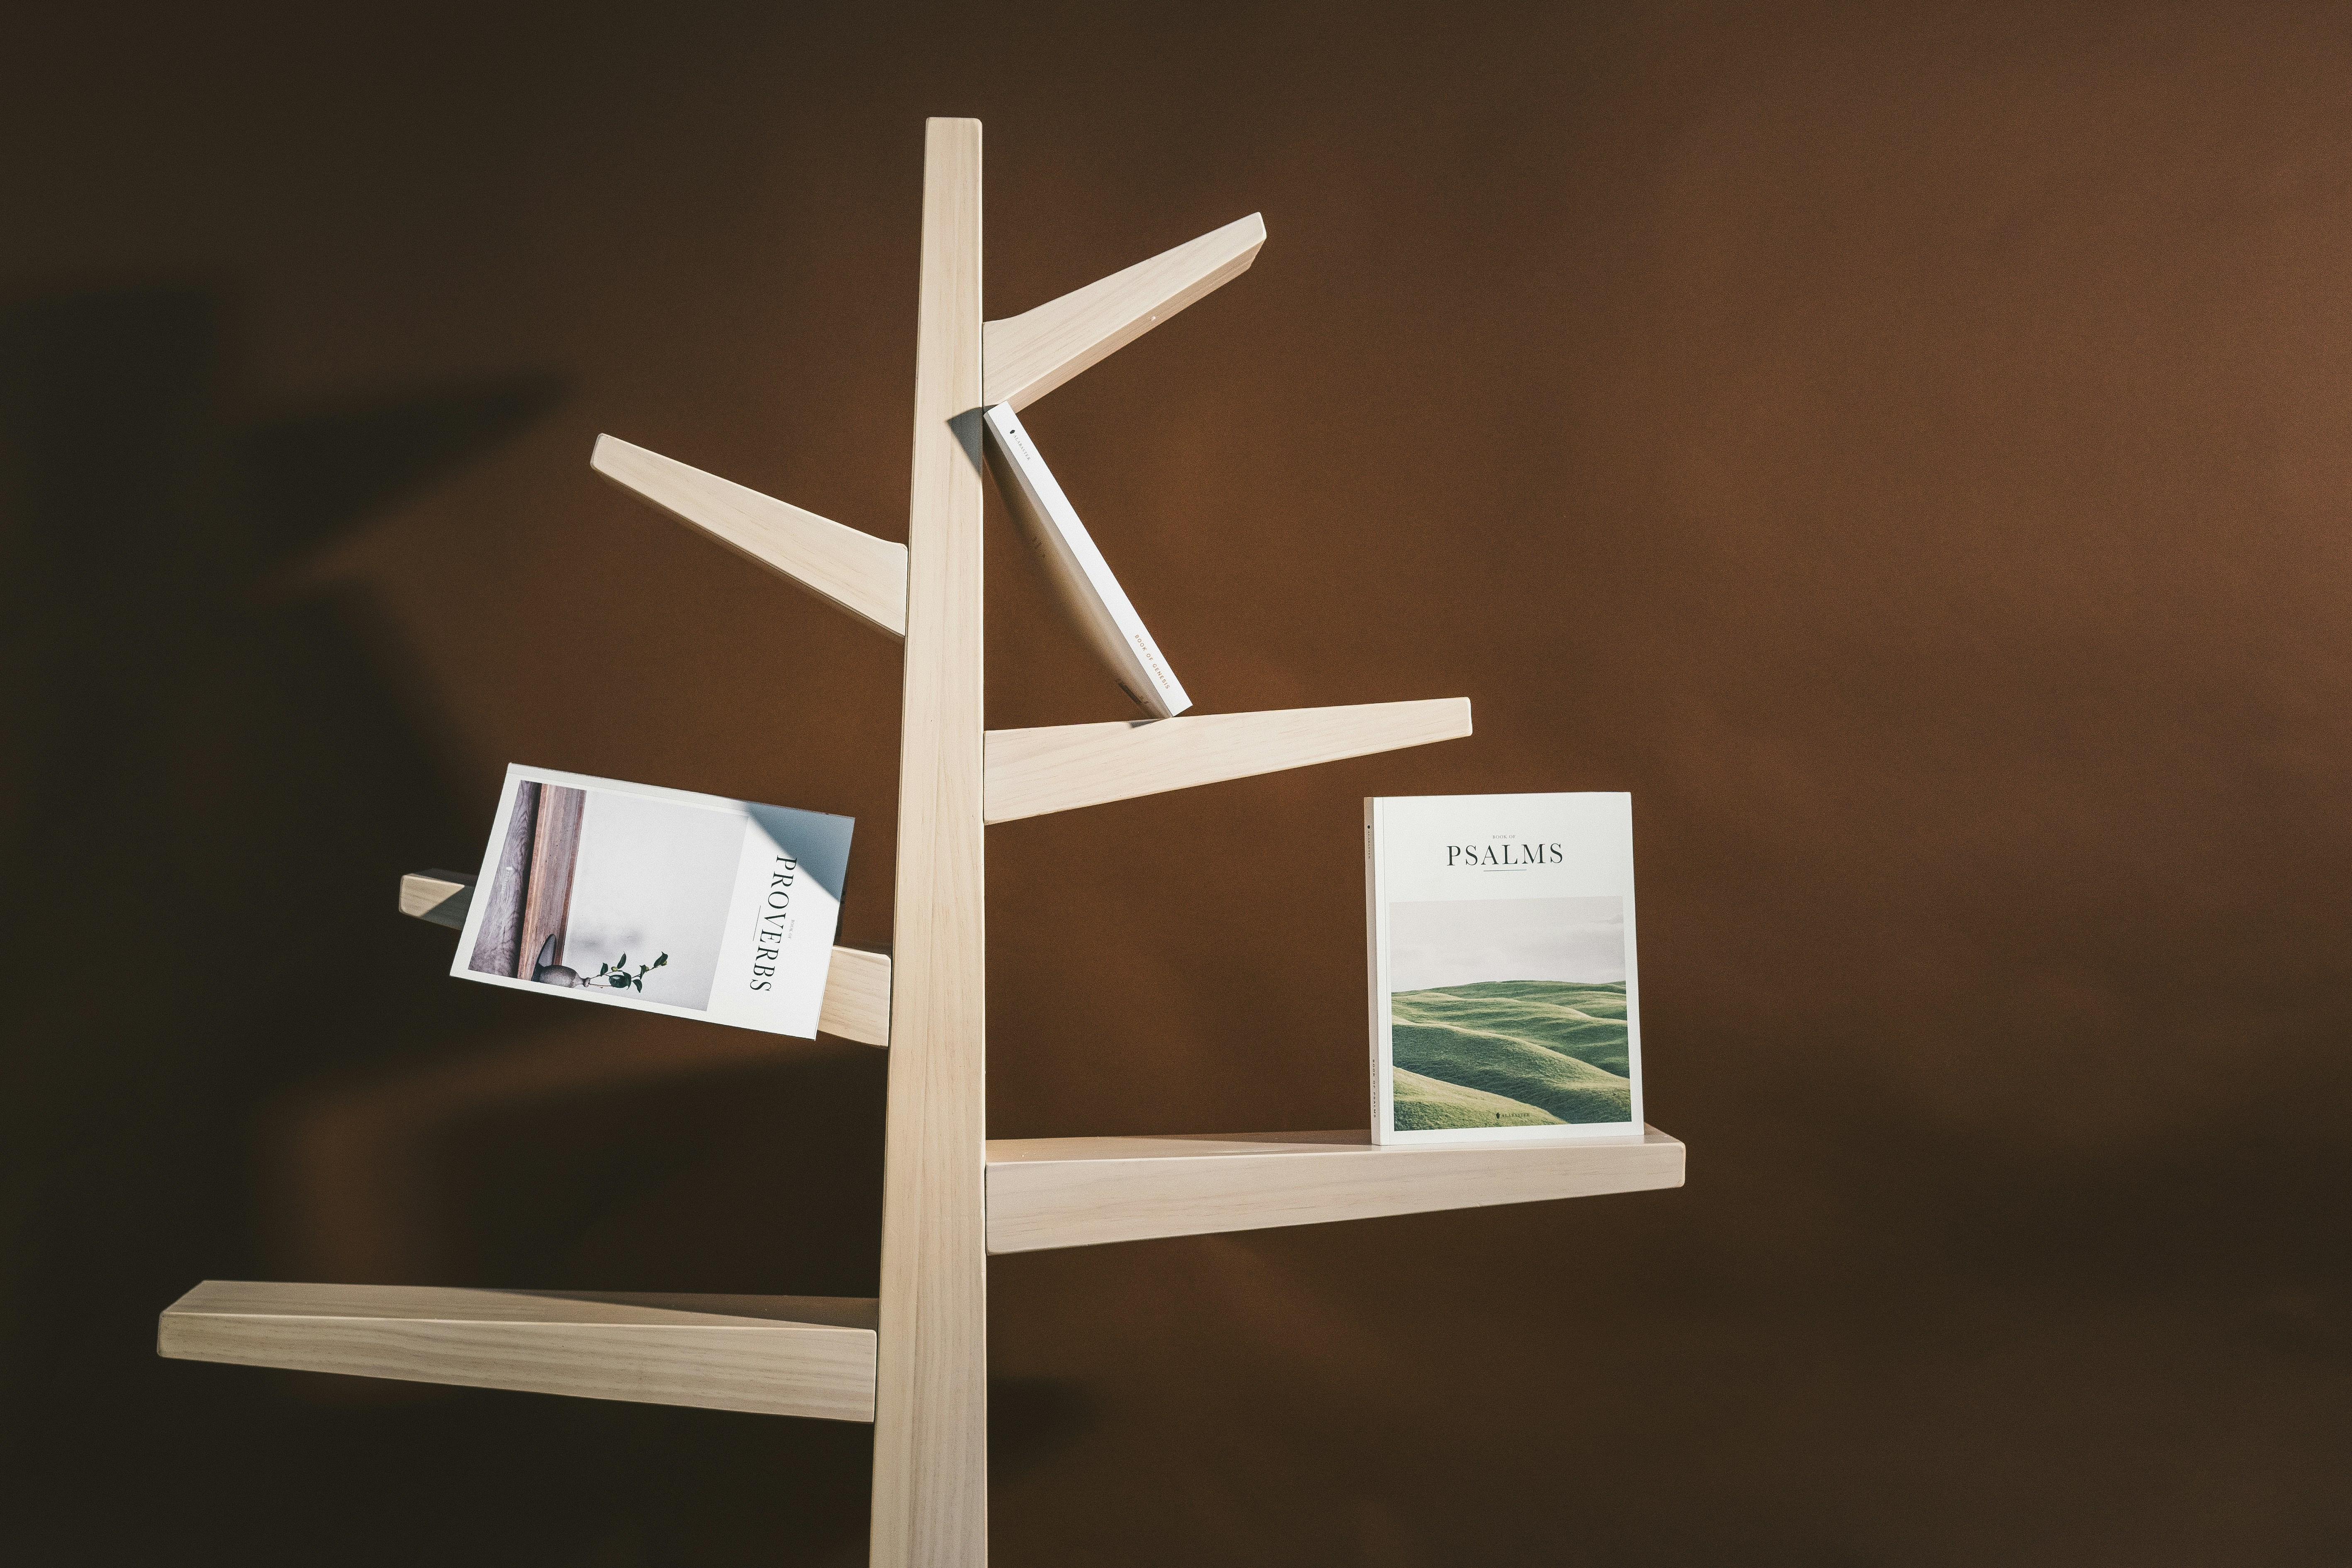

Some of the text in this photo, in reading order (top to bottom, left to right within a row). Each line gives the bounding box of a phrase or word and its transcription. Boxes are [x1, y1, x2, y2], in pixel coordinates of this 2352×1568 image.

[1013, 435, 1031, 460] ALABASTER
[1135, 634, 1147, 651] BOOK
[1152, 664, 1170, 689] GENESIS
[1446, 843, 1563, 866] PSALMS
[750, 855, 797, 992] PROVERBS
[1373, 1080, 1375, 1088] OF
